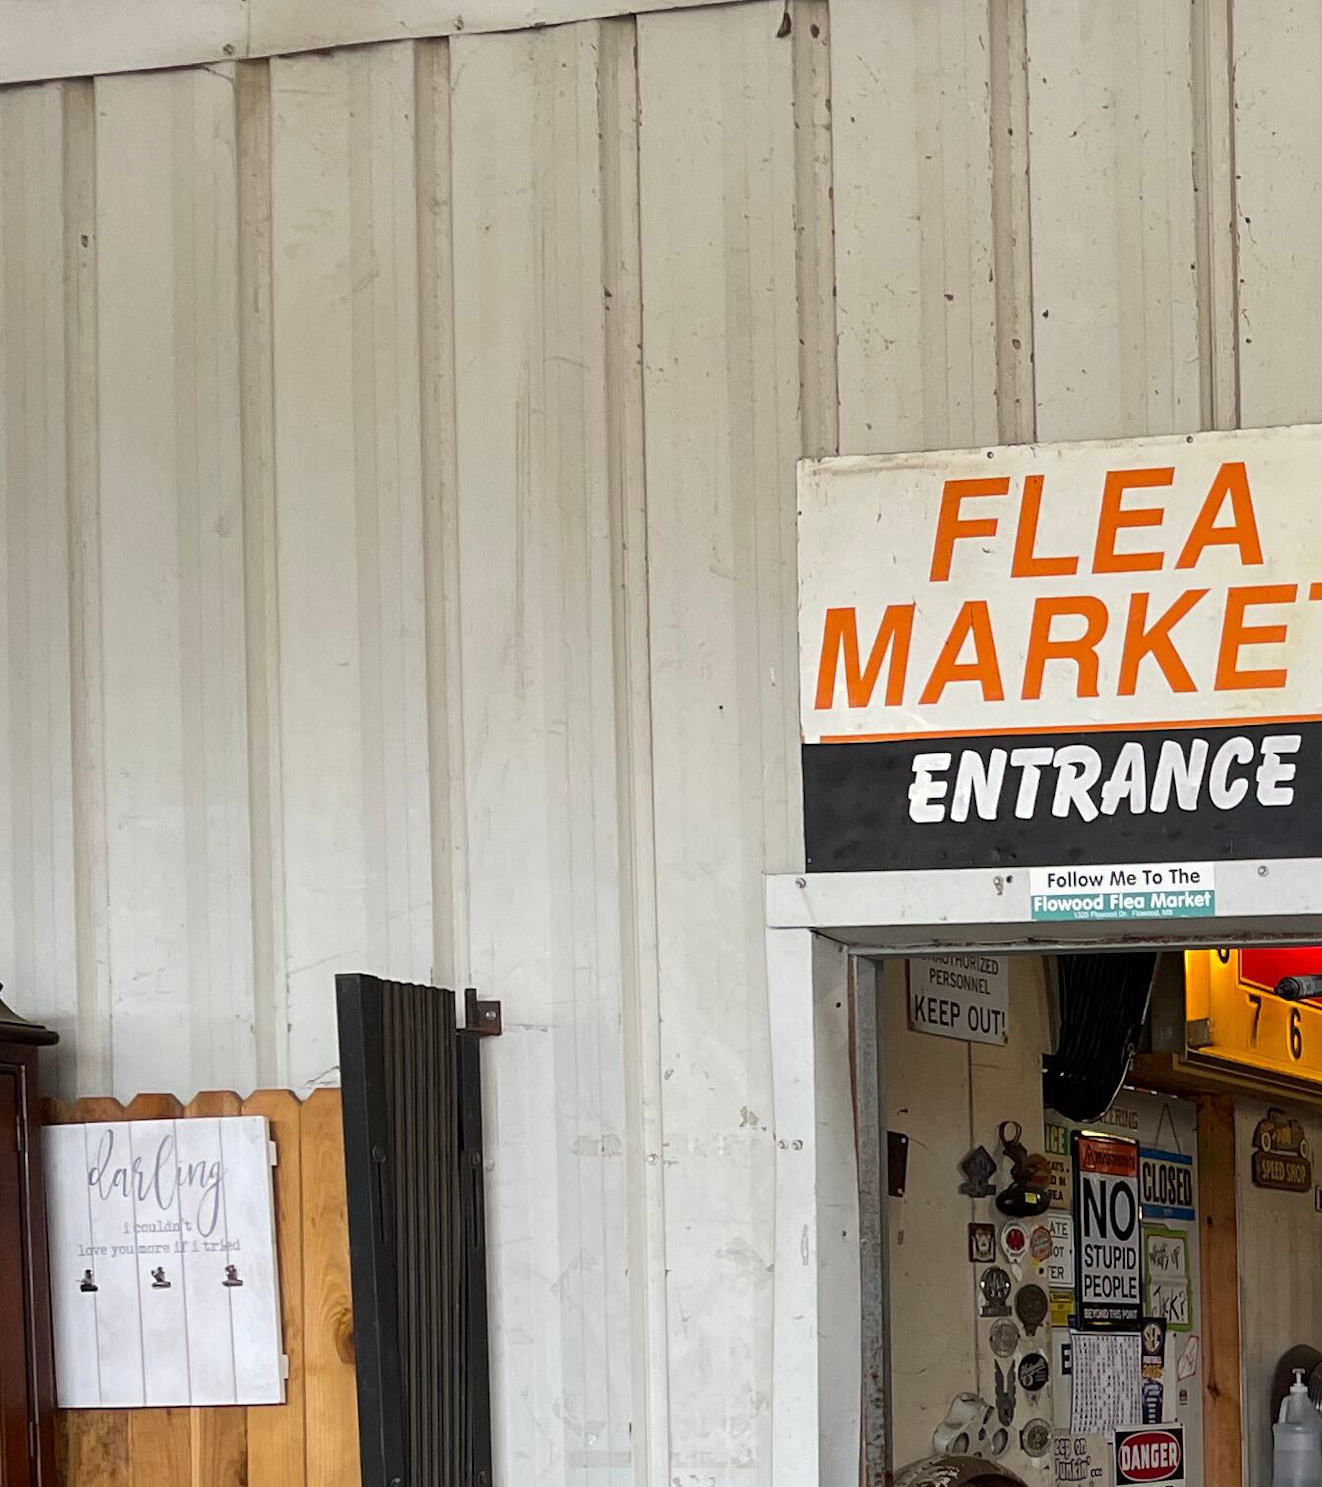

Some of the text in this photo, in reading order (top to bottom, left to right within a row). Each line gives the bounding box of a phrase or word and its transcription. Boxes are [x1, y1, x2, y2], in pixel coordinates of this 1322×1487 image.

[929, 462, 1264, 582] FLEA
[908, 735, 1302, 824] ENTRANCE
[1047, 868, 1200, 888] Follow Me To The
[1034, 891, 1212, 912] Flowood Flea Market
[929, 968, 991, 995] PERSONNEL
[914, 994, 1006, 1037] KEEP OUT!
[1289, 1007, 1302, 1060] 6
[88, 1129, 225, 1238] darling
[1142, 1161, 1193, 1207] CLOSED
[1262, 1160, 1306, 1183] SPEED SHOP
[1083, 1177, 1136, 1241] NO
[134, 1219, 192, 1233] couldn't
[78, 1244, 107, 1256] love
[112, 1246, 134, 1257] you
[138, 1243, 169, 1254] more
[202, 1238, 241, 1252] tried
[1085, 1244, 1136, 1270] STUPID
[1084, 1275, 1137, 1299] PEOPLE
[1121, 1442, 1178, 1472] DANGER
